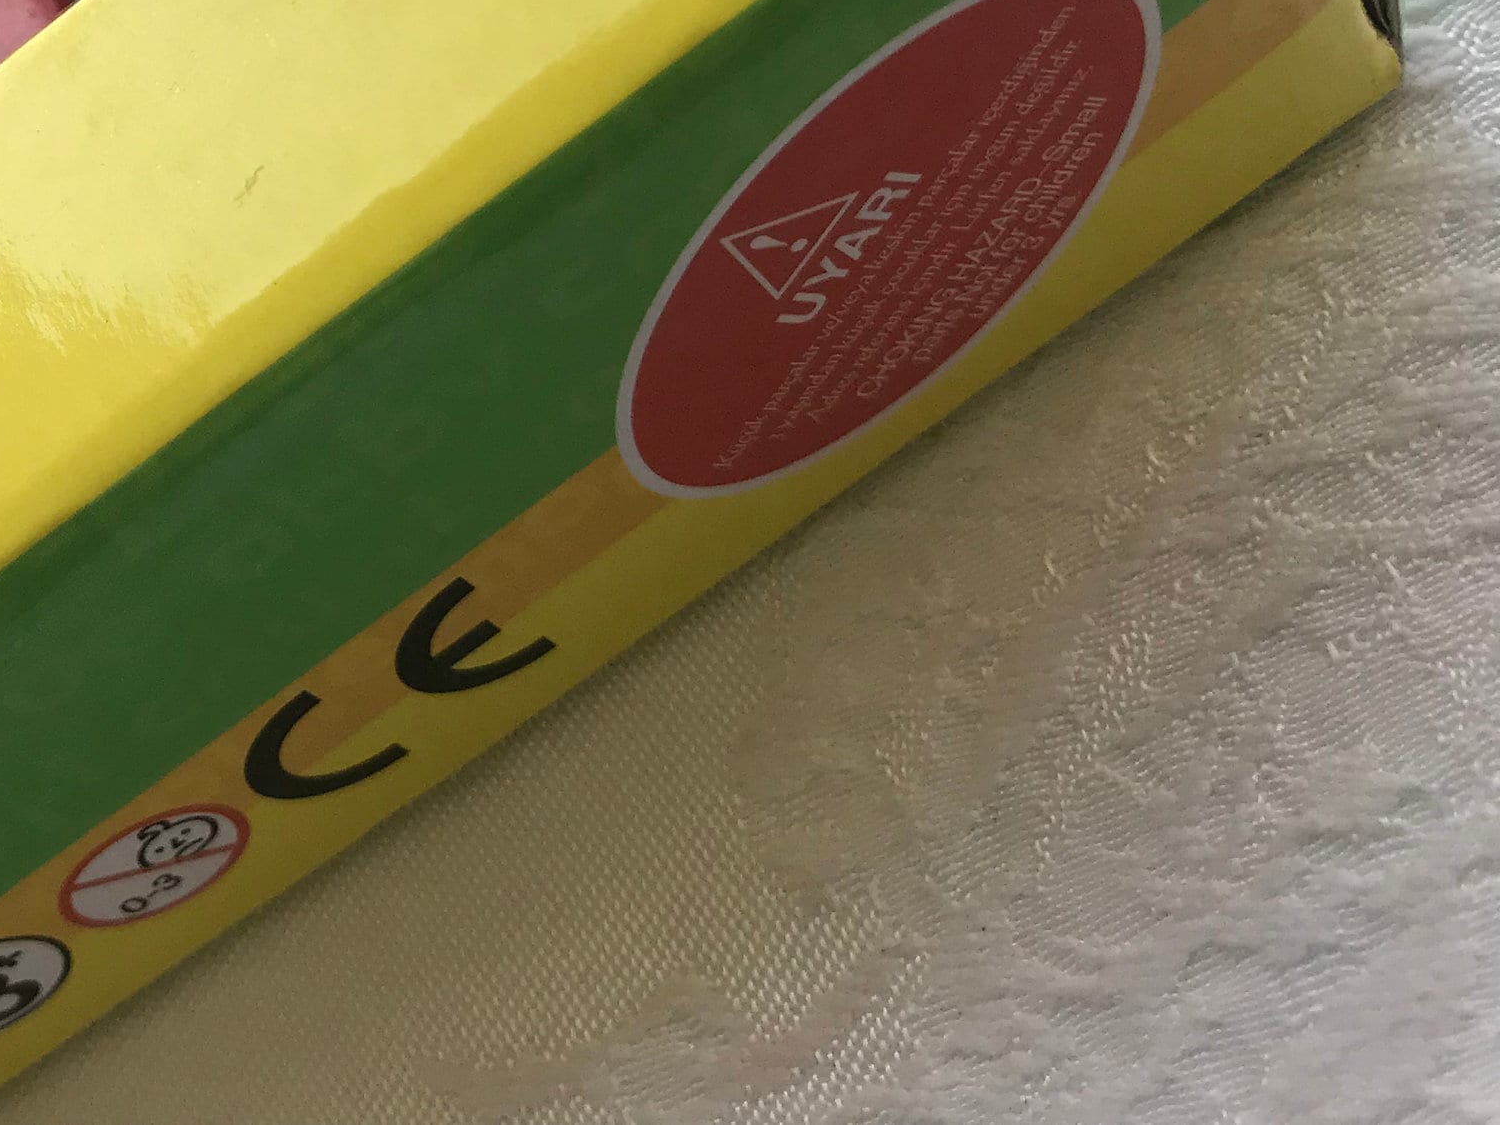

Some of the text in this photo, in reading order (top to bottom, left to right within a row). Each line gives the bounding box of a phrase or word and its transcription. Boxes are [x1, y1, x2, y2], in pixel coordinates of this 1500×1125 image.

[775, 171, 923, 323] UYARI
[952, 264, 999, 301] Not
[990, 227, 1030, 257] for
[1025, 132, 1104, 221] children
[967, 255, 1032, 316] under
[1020, 235, 1047, 248] 3
[857, 287, 959, 395] CHOKING
[244, 576, 556, 799] CE
[119, 872, 182, 914] 0-3
